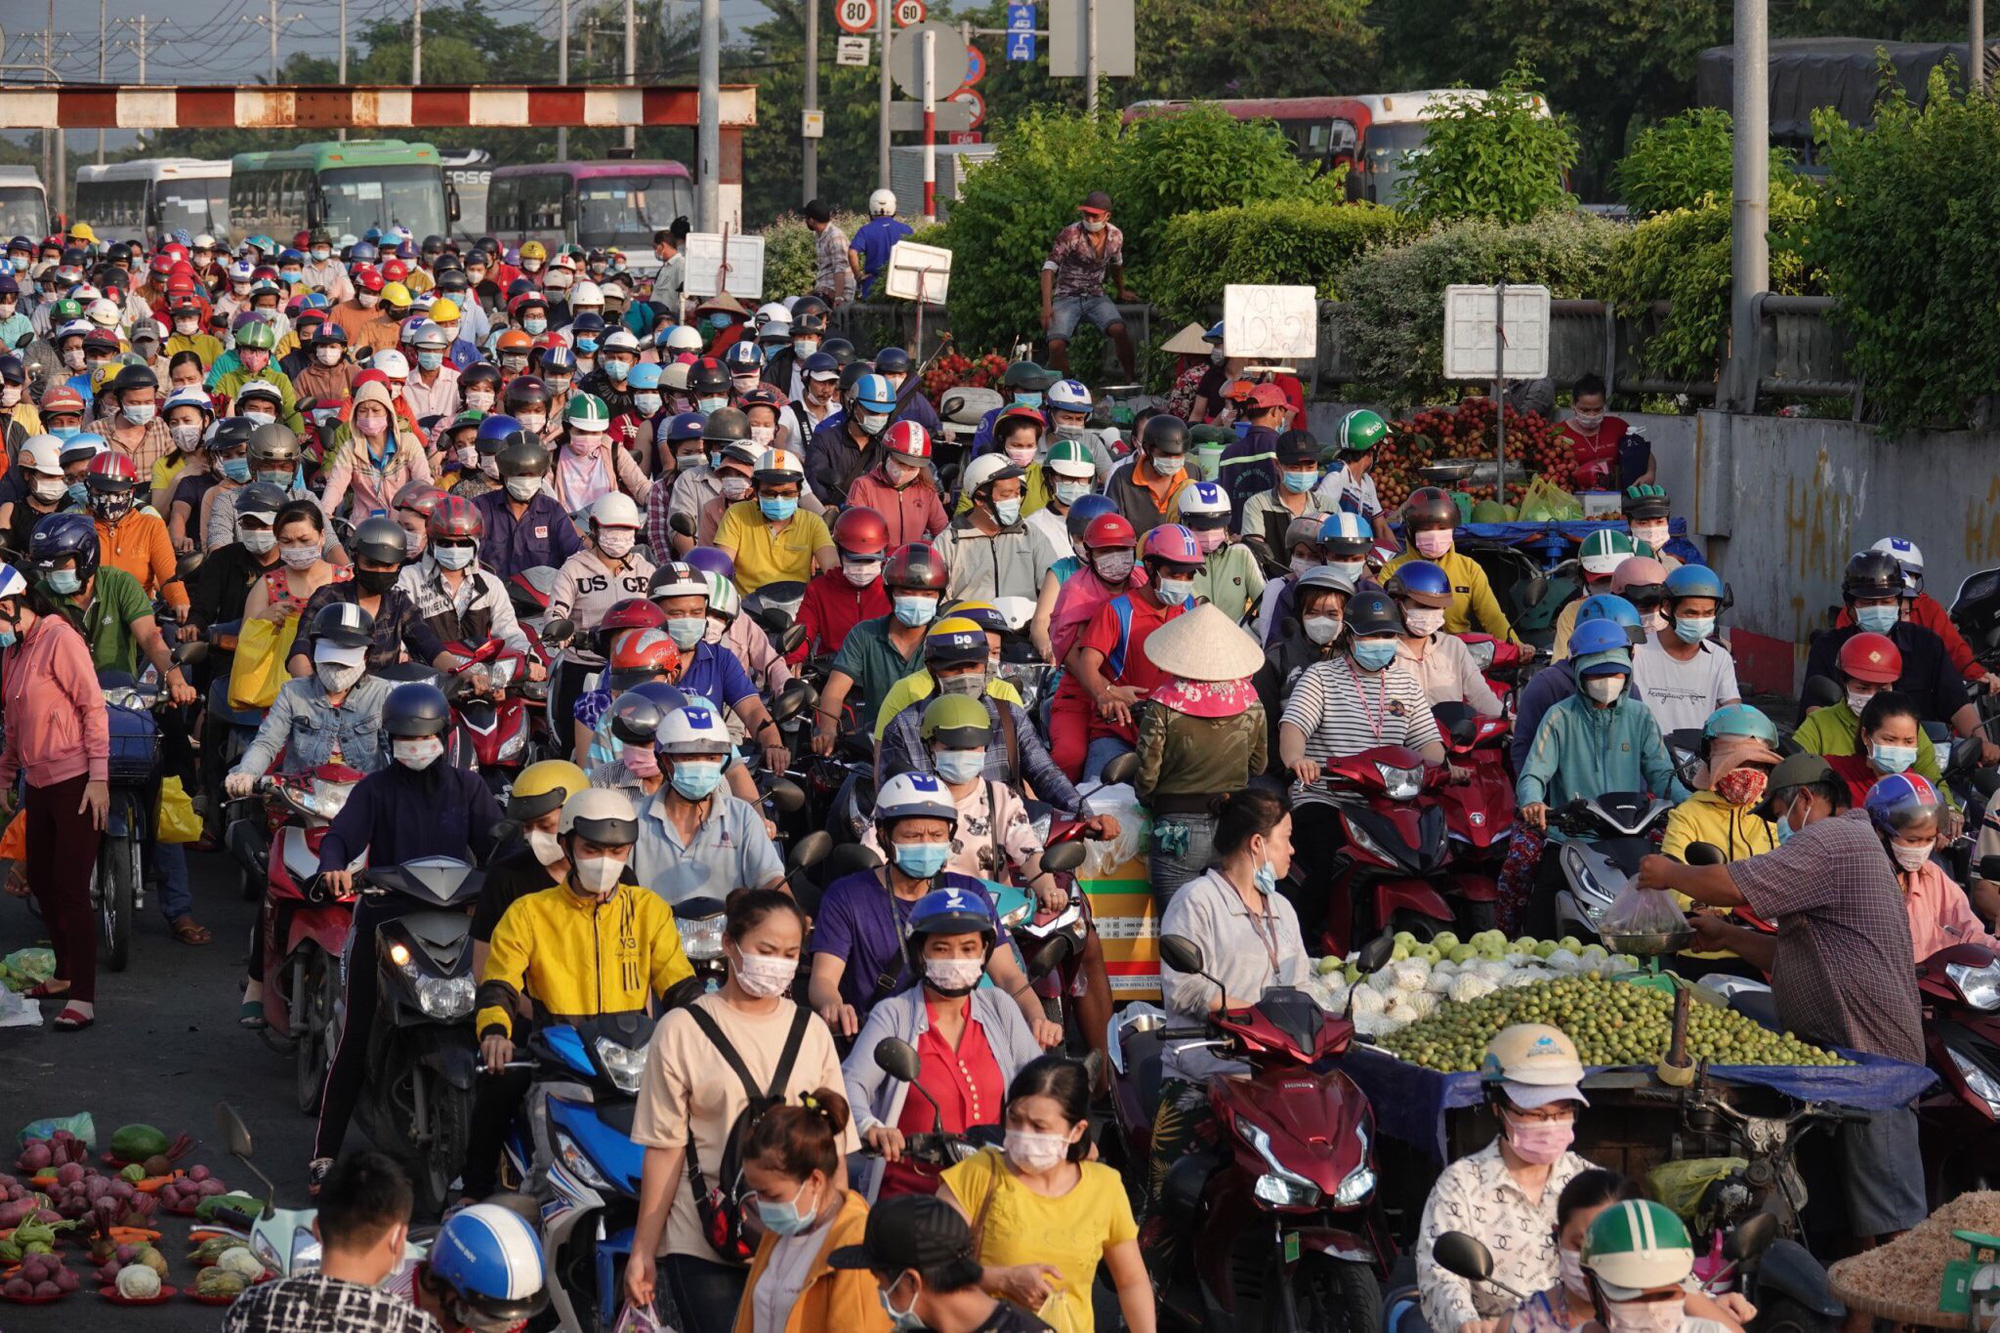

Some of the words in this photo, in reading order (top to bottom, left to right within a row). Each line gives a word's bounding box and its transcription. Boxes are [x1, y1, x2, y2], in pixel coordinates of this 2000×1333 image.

[847, 3, 866, 20] 80
[903, 5, 917, 19] 60
[1366, 421, 1382, 436] Grab
[576, 574, 608, 595] US
[987, 608, 1002, 620] be
[953, 634, 972, 646] be
